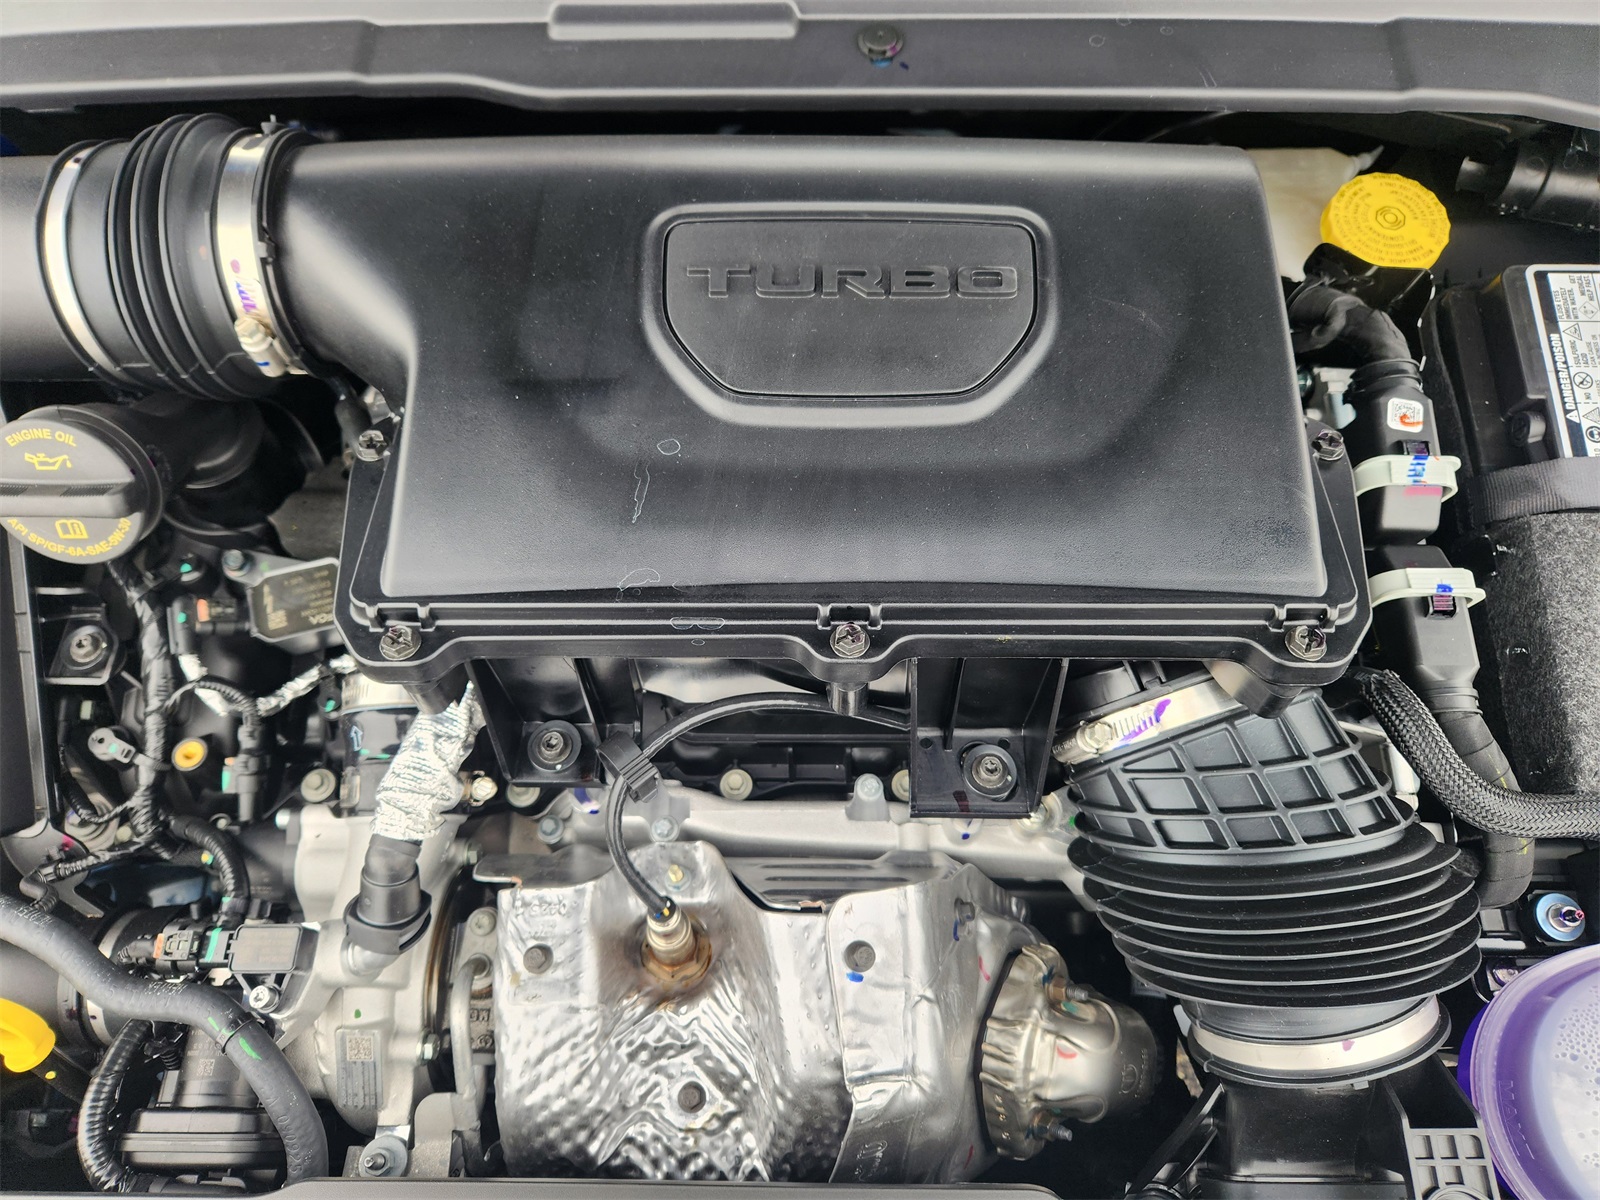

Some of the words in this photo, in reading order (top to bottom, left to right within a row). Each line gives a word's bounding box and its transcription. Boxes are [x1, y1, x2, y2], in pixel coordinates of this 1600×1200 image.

[686, 264, 1018, 299] TURBO
[1553, 290, 1561, 303] EYES
[1569, 340, 1581, 365] SULFURIC
[1580, 353, 1590, 366] ACID
[1550, 333, 1577, 410] DANGER/POISON
[5, 428, 51, 447] ENGINE
[55, 431, 77, 447] OIL
[7, 518, 28, 536] API
